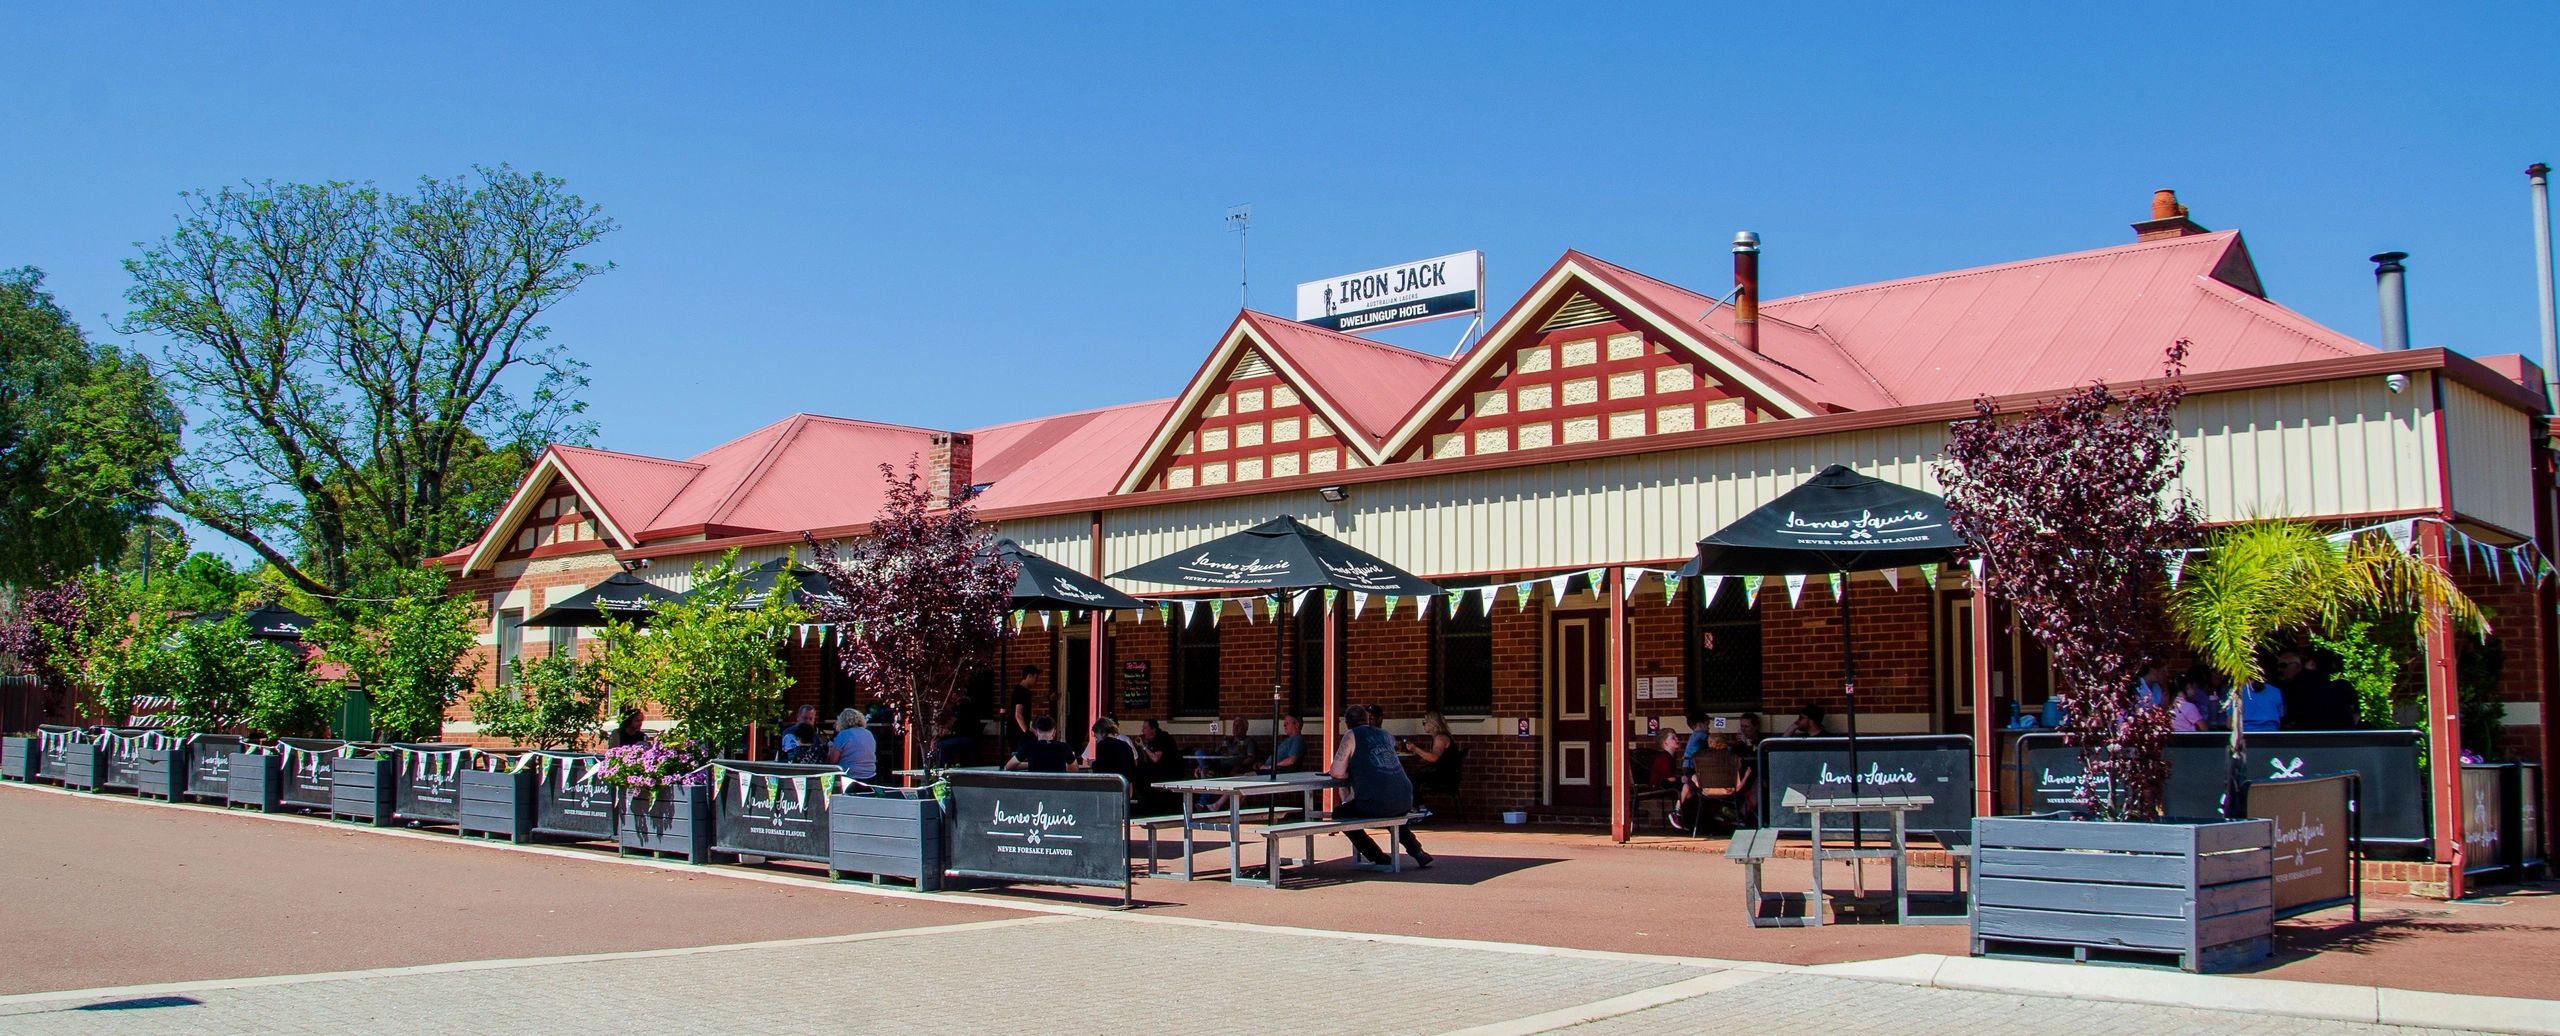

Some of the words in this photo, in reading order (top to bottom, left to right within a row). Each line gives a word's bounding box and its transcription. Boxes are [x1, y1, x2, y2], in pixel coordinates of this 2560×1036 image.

[1340, 273, 1388, 304] IRON
[1394, 261, 1446, 293] JACK
[1366, 298, 1398, 308] AUSTRALIAN
[1340, 308, 1398, 329] DWELLINGUP
[1399, 303, 1429, 318] HOTEL
[1786, 511, 1850, 529] James
[1853, 509, 1929, 529] Squire
[1882, 535, 1930, 544] FLAVOUR
[1191, 551, 1240, 570] James
[1240, 558, 1290, 573] Squire
[1715, 719, 1724, 727] 25
[1820, 762, 1863, 785] Jams
[1864, 761, 1917, 785] Squire
[2042, 768, 2077, 786] James
[746, 787, 772, 809] Jame
[992, 799, 1030, 826] James
[1031, 801, 1077, 831] Squire
[2273, 815, 2298, 848] James
[2297, 811, 2325, 846] Squire
[997, 845, 1017, 853] NEVER
[1017, 846, 1045, 855] FORSAKE
[1045, 848, 1073, 856] FLAVOUR
